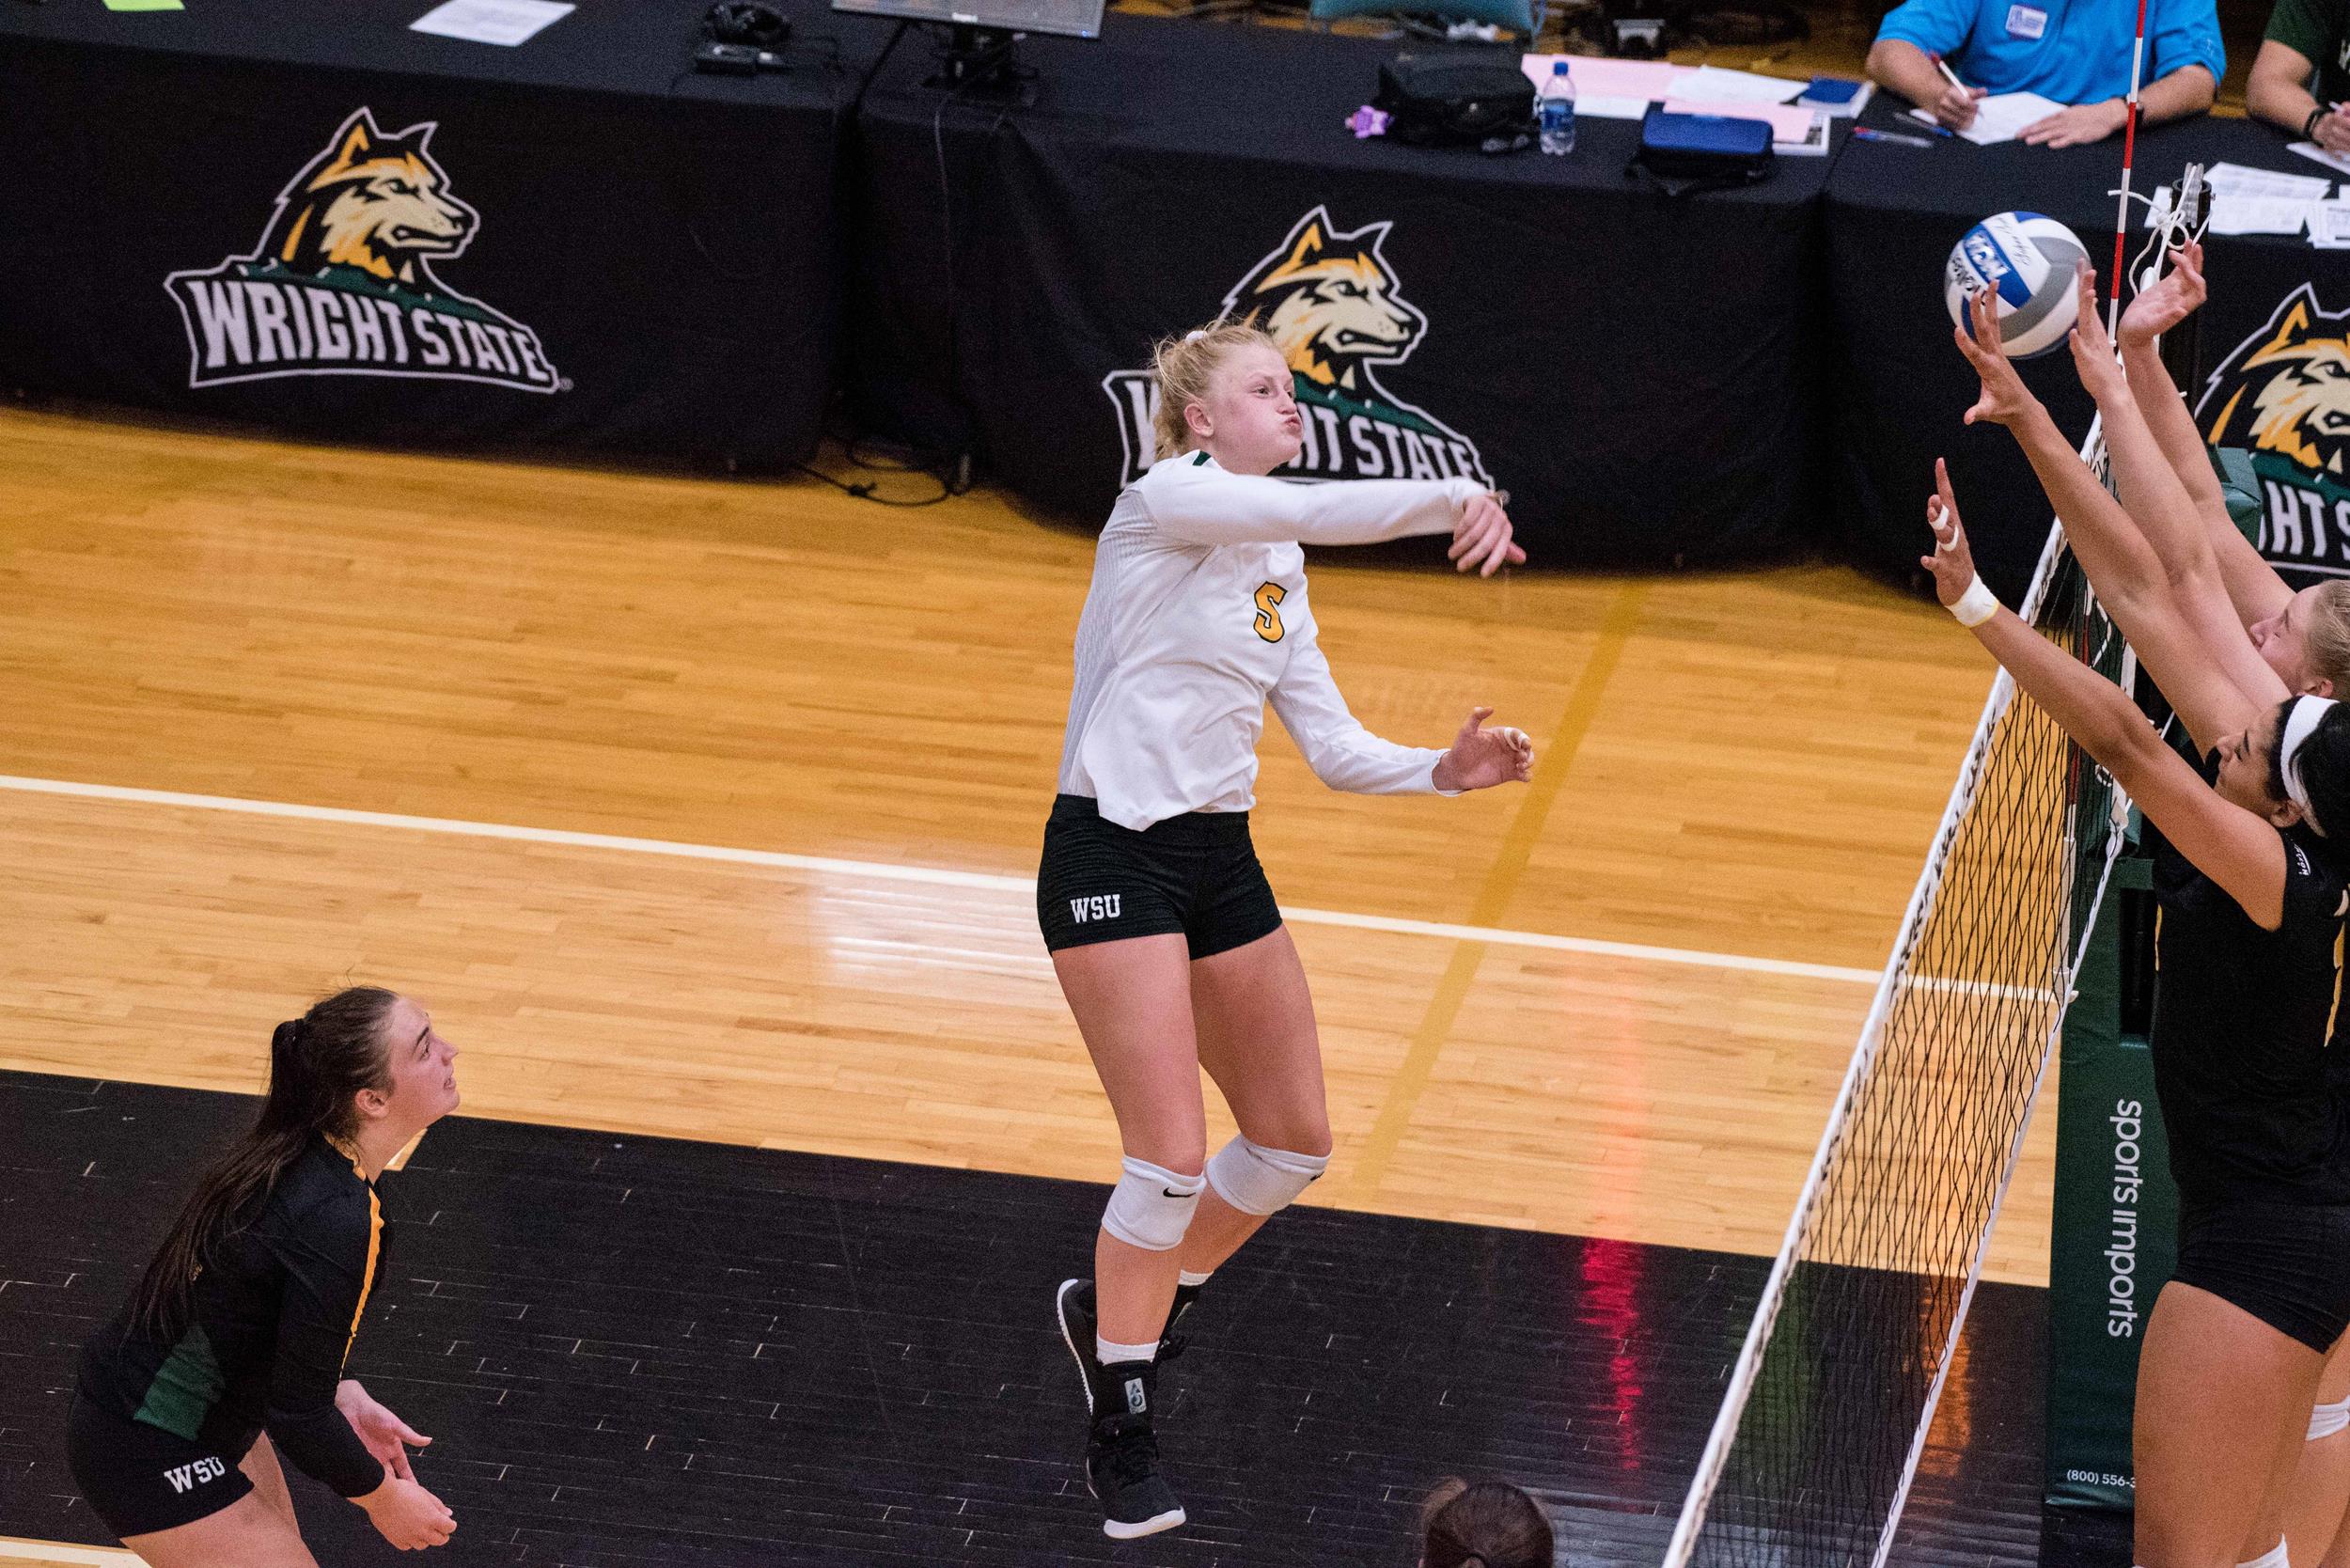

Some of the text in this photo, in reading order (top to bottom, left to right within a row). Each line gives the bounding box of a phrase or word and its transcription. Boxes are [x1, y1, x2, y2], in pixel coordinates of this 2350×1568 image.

[186, 280, 551, 382] WRIGHT STATE
[1070, 893, 1120, 924] WSU
[2109, 1098, 2143, 1204] sports
[163, 1456, 226, 1494] WSU
[2066, 1469, 2099, 1485] (800)
